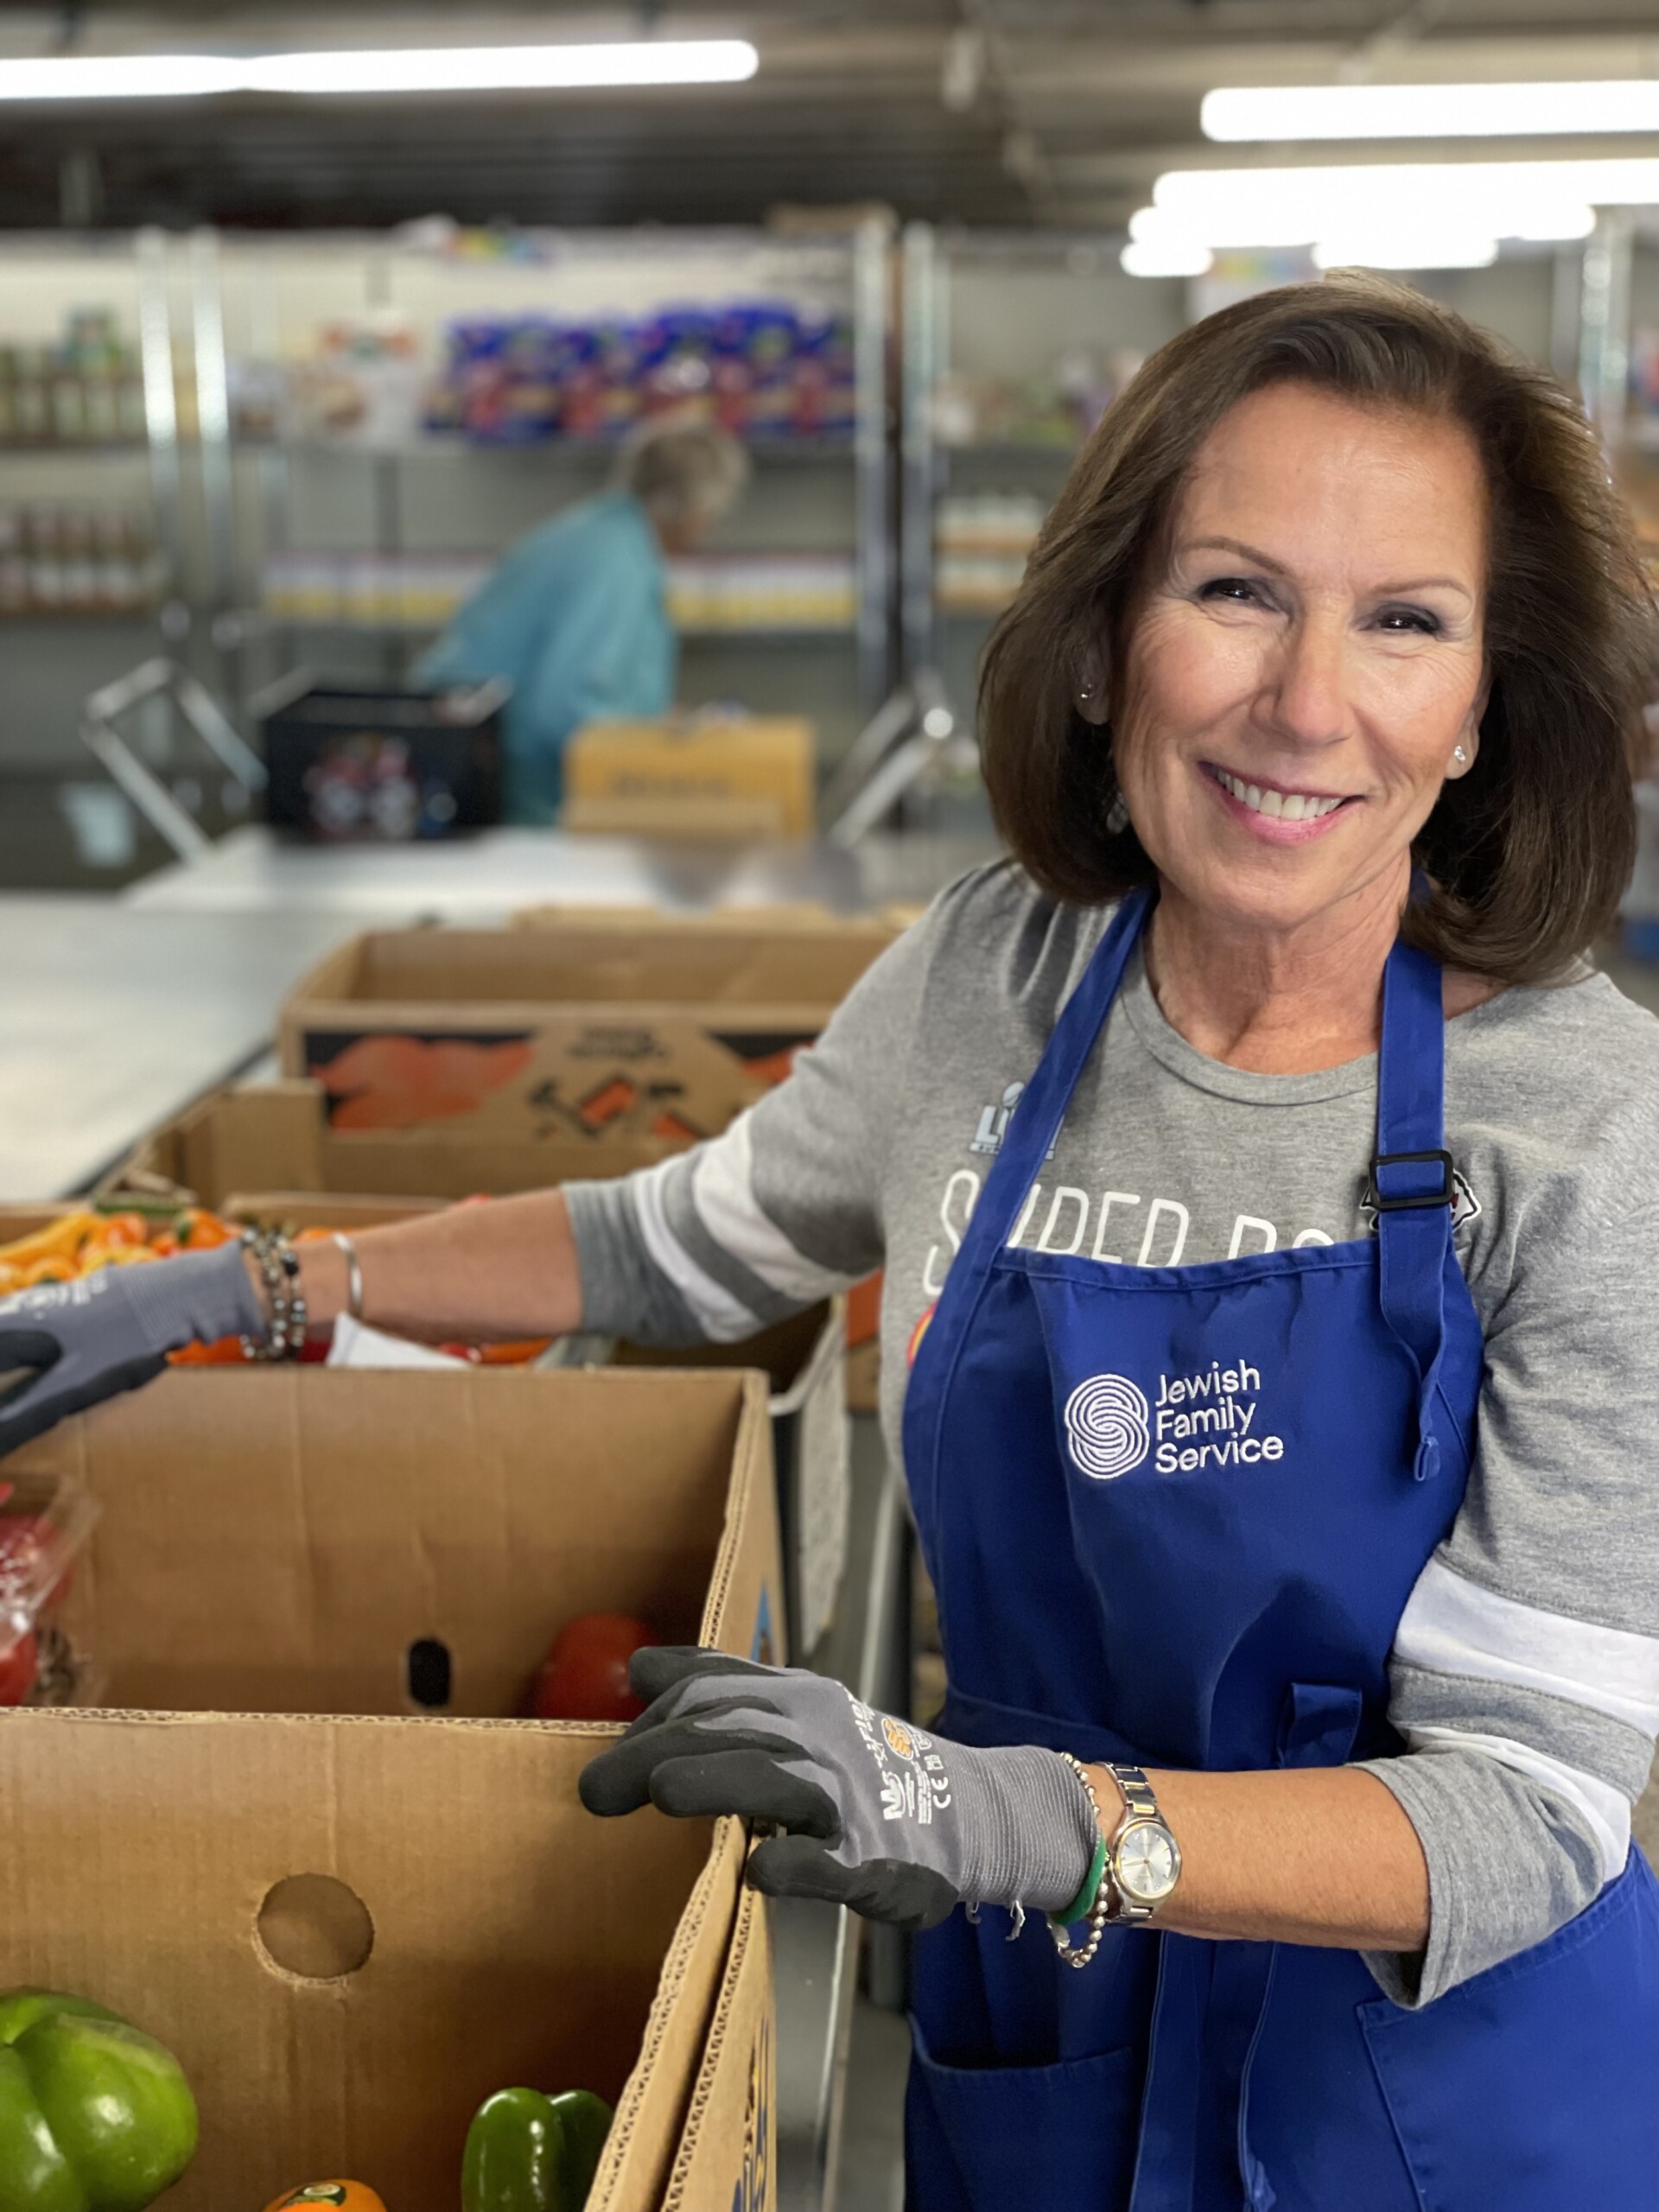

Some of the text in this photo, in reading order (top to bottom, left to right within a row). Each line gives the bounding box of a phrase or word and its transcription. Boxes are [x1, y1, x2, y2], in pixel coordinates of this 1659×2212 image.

[1155, 1359, 1260, 1407] Jewish
[1156, 1395, 1256, 1440] Family
[1155, 1432, 1284, 1473] Service
